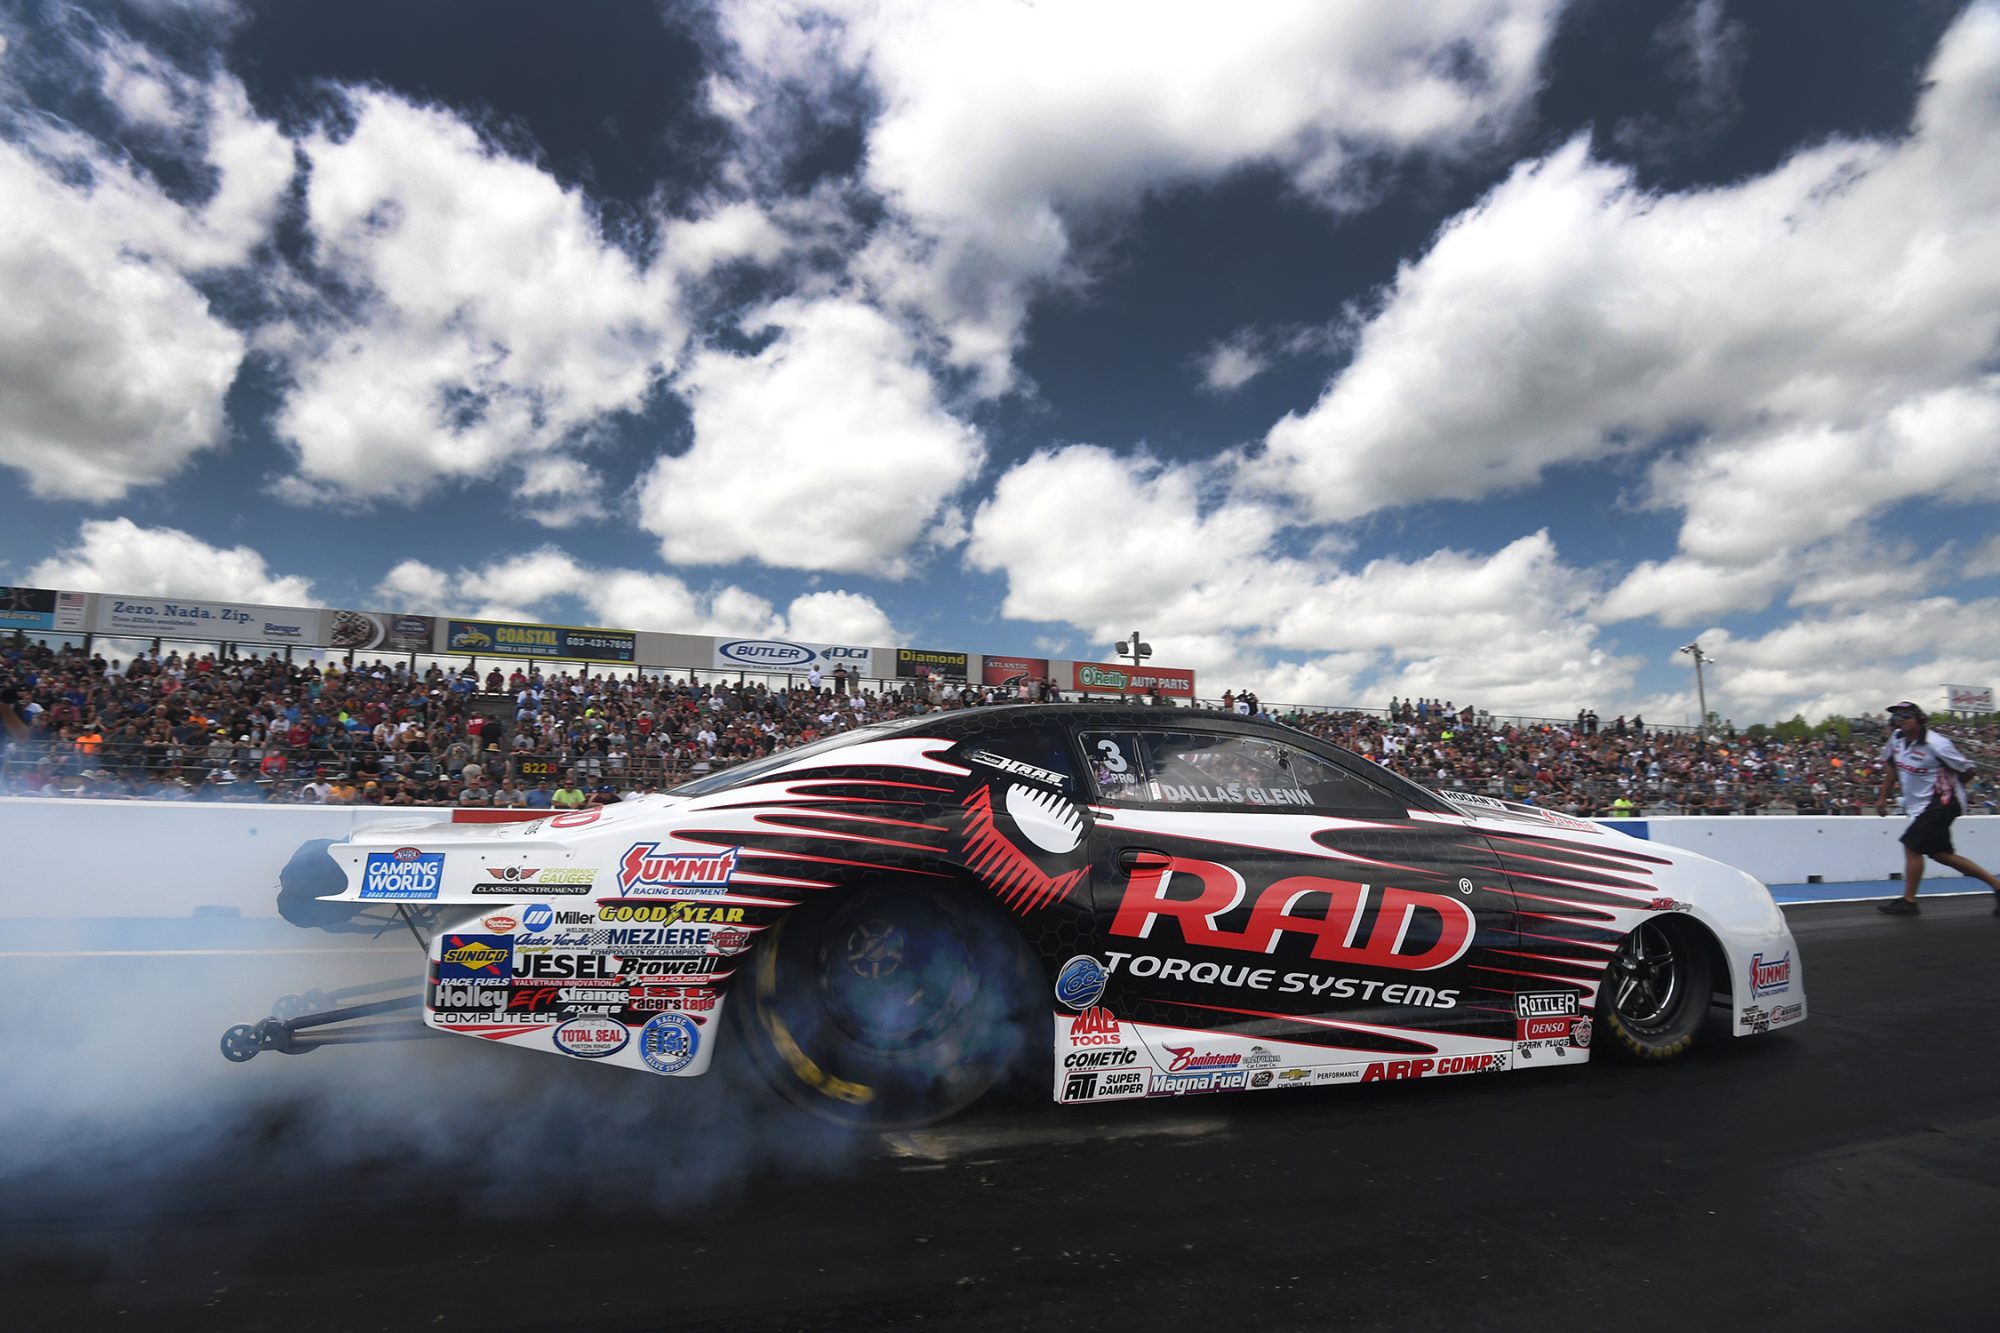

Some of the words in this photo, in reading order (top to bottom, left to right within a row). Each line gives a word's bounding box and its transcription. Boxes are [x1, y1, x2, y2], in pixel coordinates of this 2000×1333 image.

[113, 601, 159, 615] Zero.
[163, 604, 216, 620] Nada.
[221, 608, 255, 624] Zip.
[264, 622, 301, 633] Bangor
[496, 627, 558, 646] COASTAL
[736, 645, 801, 659] BUTLER
[832, 647, 869, 659] DGI
[900, 650, 965, 665] Diamond
[1080, 666, 1128, 690] O'Reilly
[1158, 679, 1190, 690] PARTS
[1098, 739, 1128, 772] 3
[999, 757, 1064, 784] HAAS
[1110, 773, 1136, 784] PRO
[1160, 784, 1244, 803] DALLAS
[1246, 787, 1315, 805] GLENN
[1444, 791, 1501, 808] HOGAN'S
[369, 862, 439, 875] CAMPING
[368, 875, 436, 891] WORLD
[538, 874, 594, 884] GAUGES
[519, 886, 587, 894] INSTRUMENTS
[671, 888, 727, 896] EQUIPMENT
[555, 911, 595, 924] Miller
[1108, 851, 1477, 972] RAD
[608, 929, 711, 945] MEZIERE
[447, 950, 505, 962] SUNOCO
[512, 954, 611, 979] JESEL
[618, 956, 717, 975] Browell
[441, 978, 473, 987] RACE
[474, 978, 511, 987] FUELS
[1104, 951, 1276, 992] TORQUE
[1279, 972, 1461, 1010] SYSTEMS
[435, 985, 509, 1013] Holley
[557, 986, 630, 1004] Strange
[562, 1004, 623, 1014] AXLES
[1518, 993, 1576, 1016] ROTTLER
[656, 1015, 688, 1026] RACING
[1070, 1006, 1120, 1036] MAC
[1531, 1022, 1565, 1034] DENSO
[561, 1029, 593, 1042] TOTAL
[595, 1029, 622, 1042] SEAL
[1070, 1034, 1121, 1047] TOOLS
[1517, 1040, 1543, 1049] SPARK
[1545, 1038, 1569, 1048] PLUGS
[645, 1054, 664, 1071] VALVE
[665, 1053, 693, 1072] SPRINGS
[1064, 1046, 1138, 1068] COMETIC
[1317, 1070, 1360, 1080] PERFORMANCE
[1360, 1058, 1435, 1084] ARP
[1437, 1054, 1494, 1075] COMP
[1064, 1072, 1099, 1101] ATI
[1105, 1073, 1141, 1084] SUPER
[1150, 1072, 1248, 1095] MagnaFuel
[1098, 1083, 1144, 1096] DAMPER
